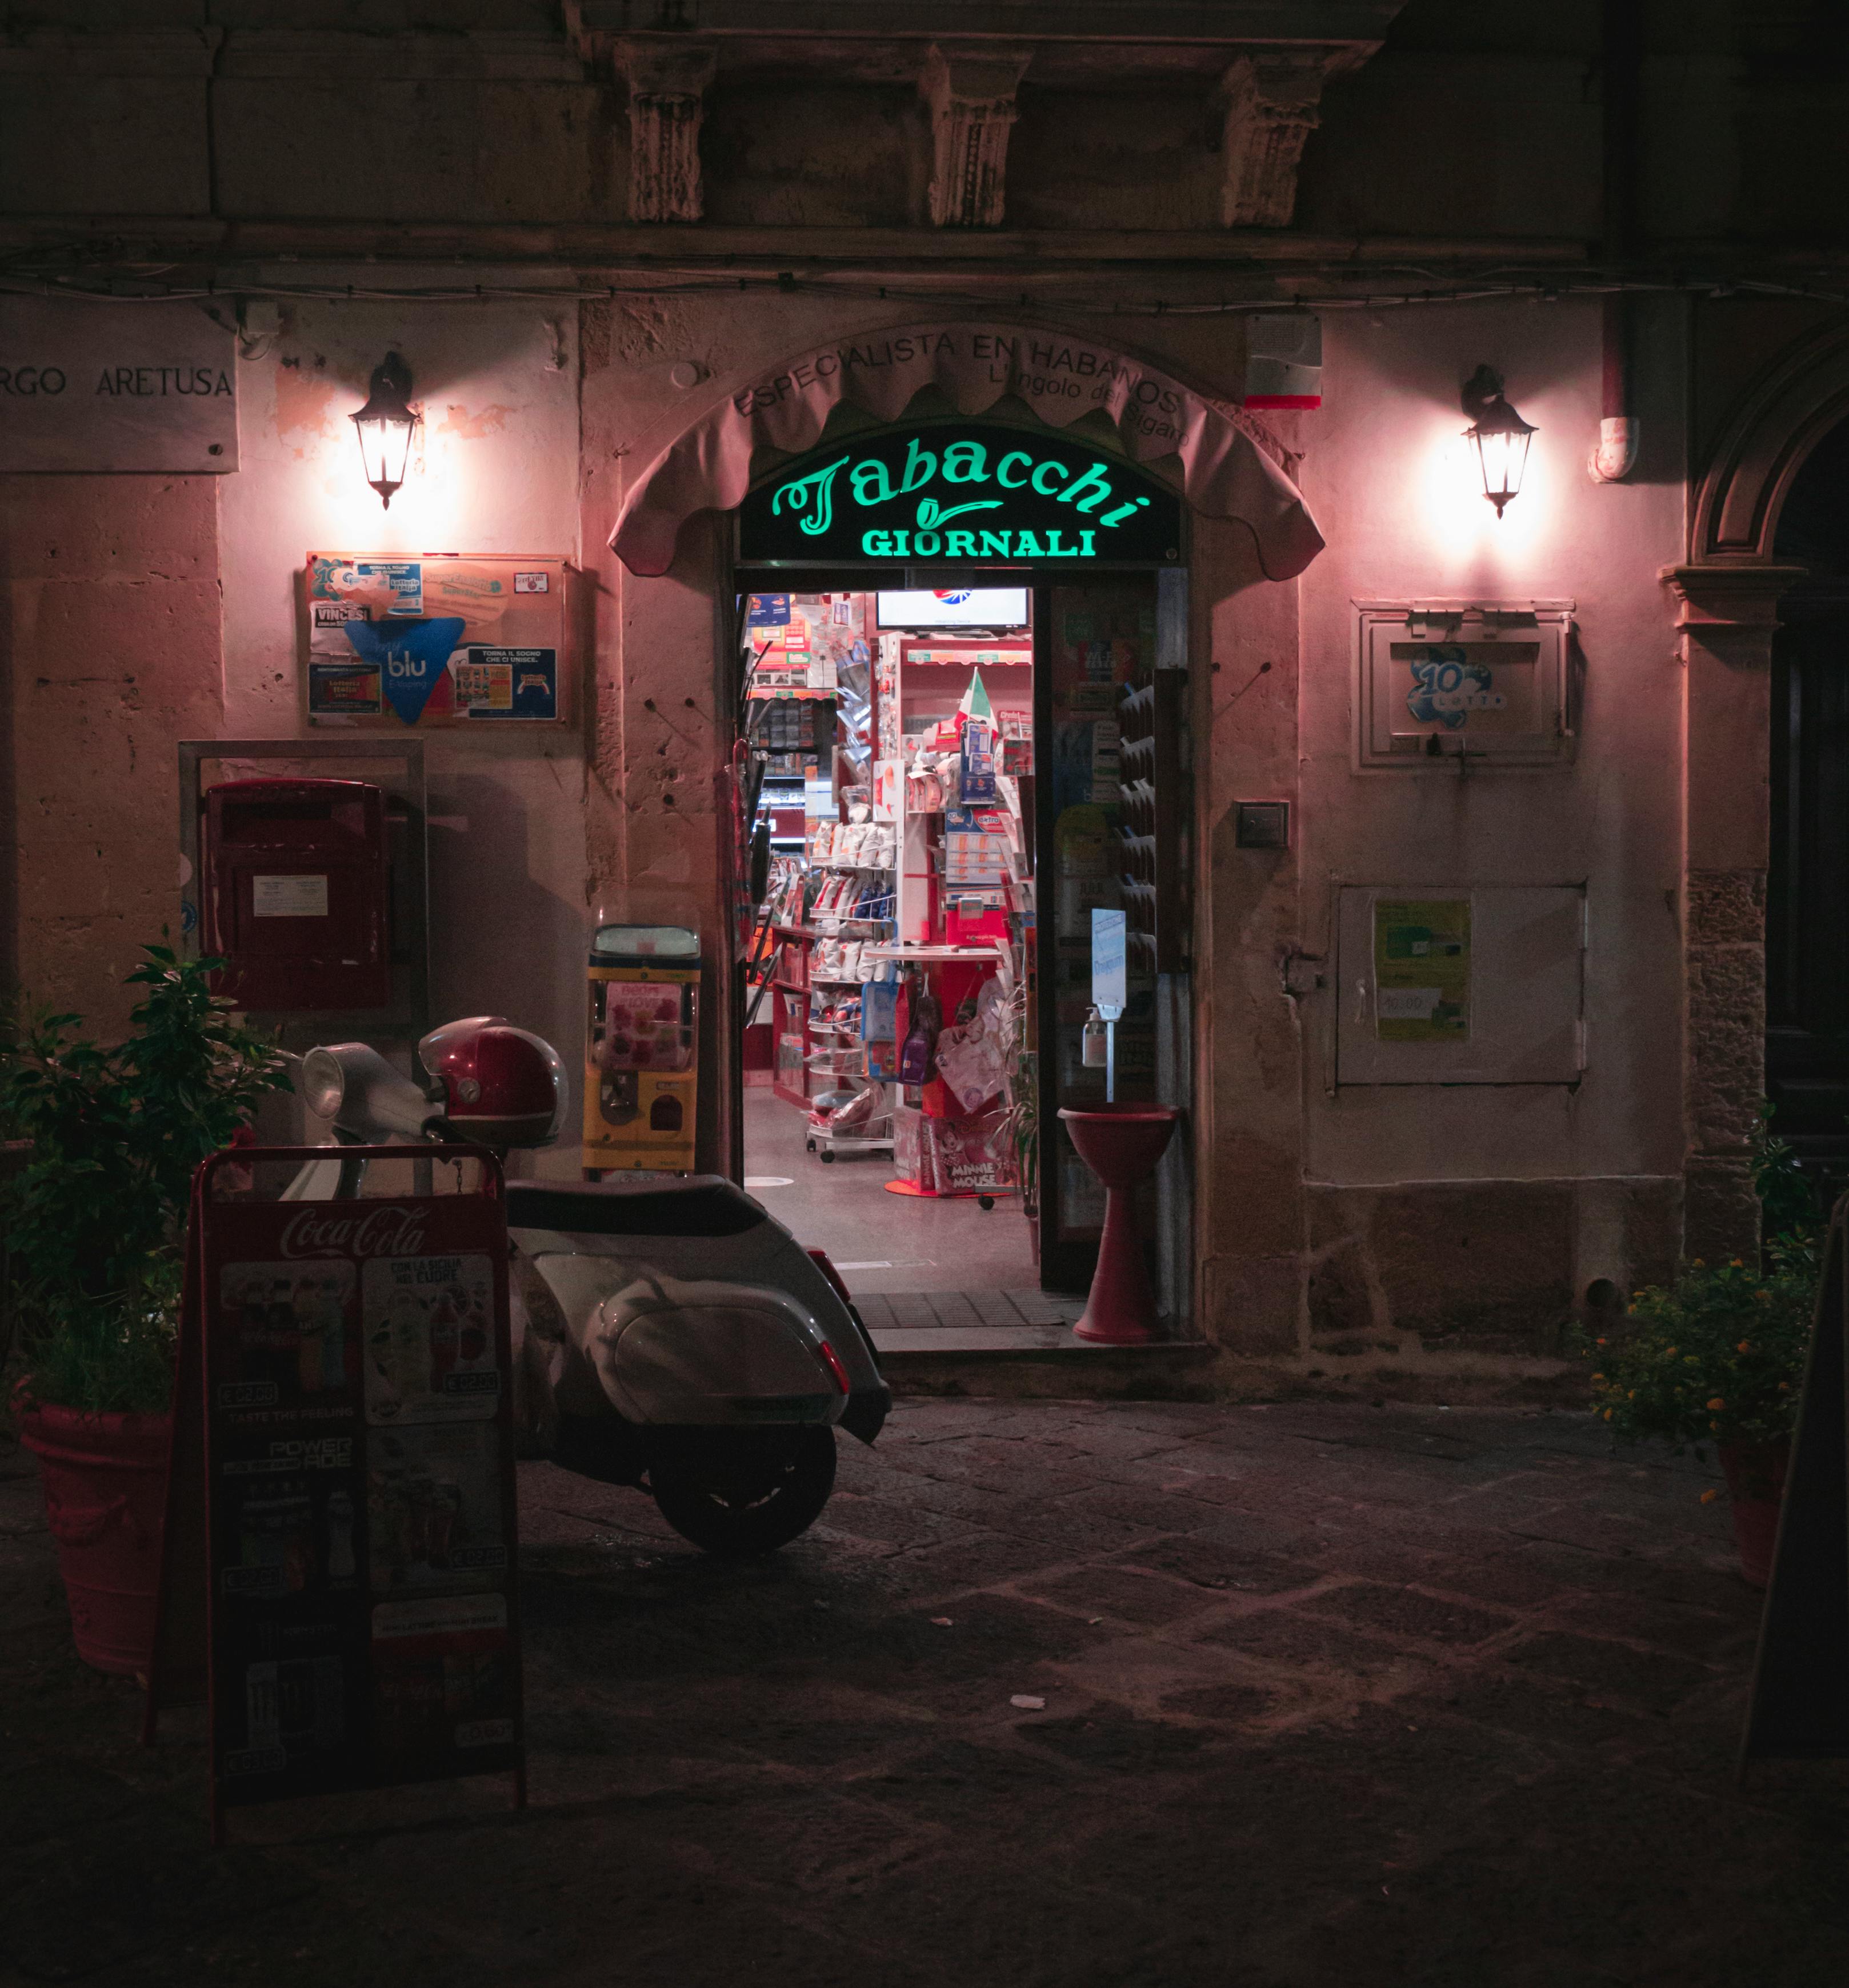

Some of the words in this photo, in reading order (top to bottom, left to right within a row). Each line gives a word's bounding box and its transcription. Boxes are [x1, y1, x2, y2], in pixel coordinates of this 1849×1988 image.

[96, 367, 233, 395] ARETUSA
[734, 333, 955, 418] ESPECIALISTA
[973, 335, 1016, 359] EN
[1031, 342, 1180, 414] HABANOS
[990, 363, 1080, 399] L'ngolo
[772, 438, 1150, 535] Tabacchi
[862, 529, 1096, 558] GIORNALI
[388, 650, 426, 677] blu
[1419, 663, 1463, 694] 10
[978, 816, 999, 824] extra
[952, 1163, 995, 1176] MINNIE
[953, 1174, 997, 1189] MOUSE
[417, 1269, 458, 1283] CUORE
[229, 1412, 269, 1424] TASTE
[271, 1410, 298, 1421] THE
[301, 1407, 354, 1419] FEELING
[269, 1437, 353, 1457] POWER
